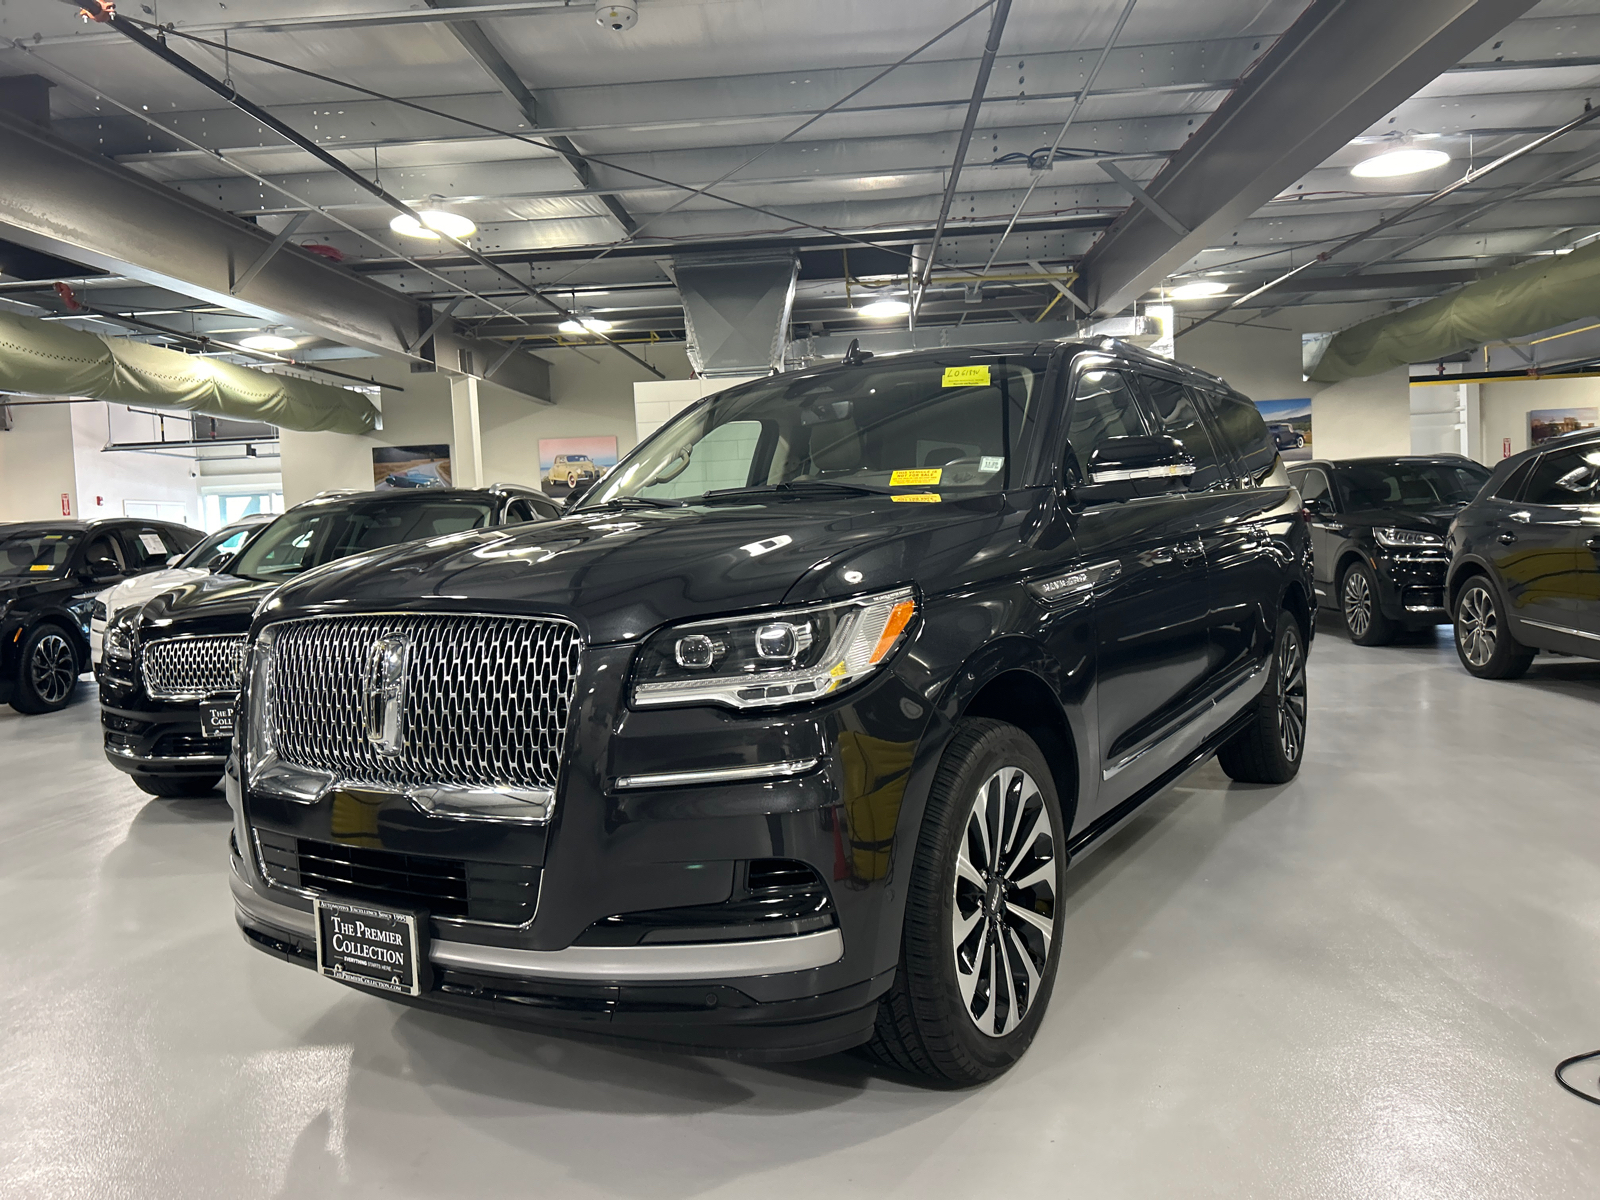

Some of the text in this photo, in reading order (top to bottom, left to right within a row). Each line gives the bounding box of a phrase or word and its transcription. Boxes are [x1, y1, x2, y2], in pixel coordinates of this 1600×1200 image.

[331, 916, 403, 946] THE PREMIER
[332, 934, 404, 965] COLLECTION
[344, 956, 367, 966] EVERYTHING
